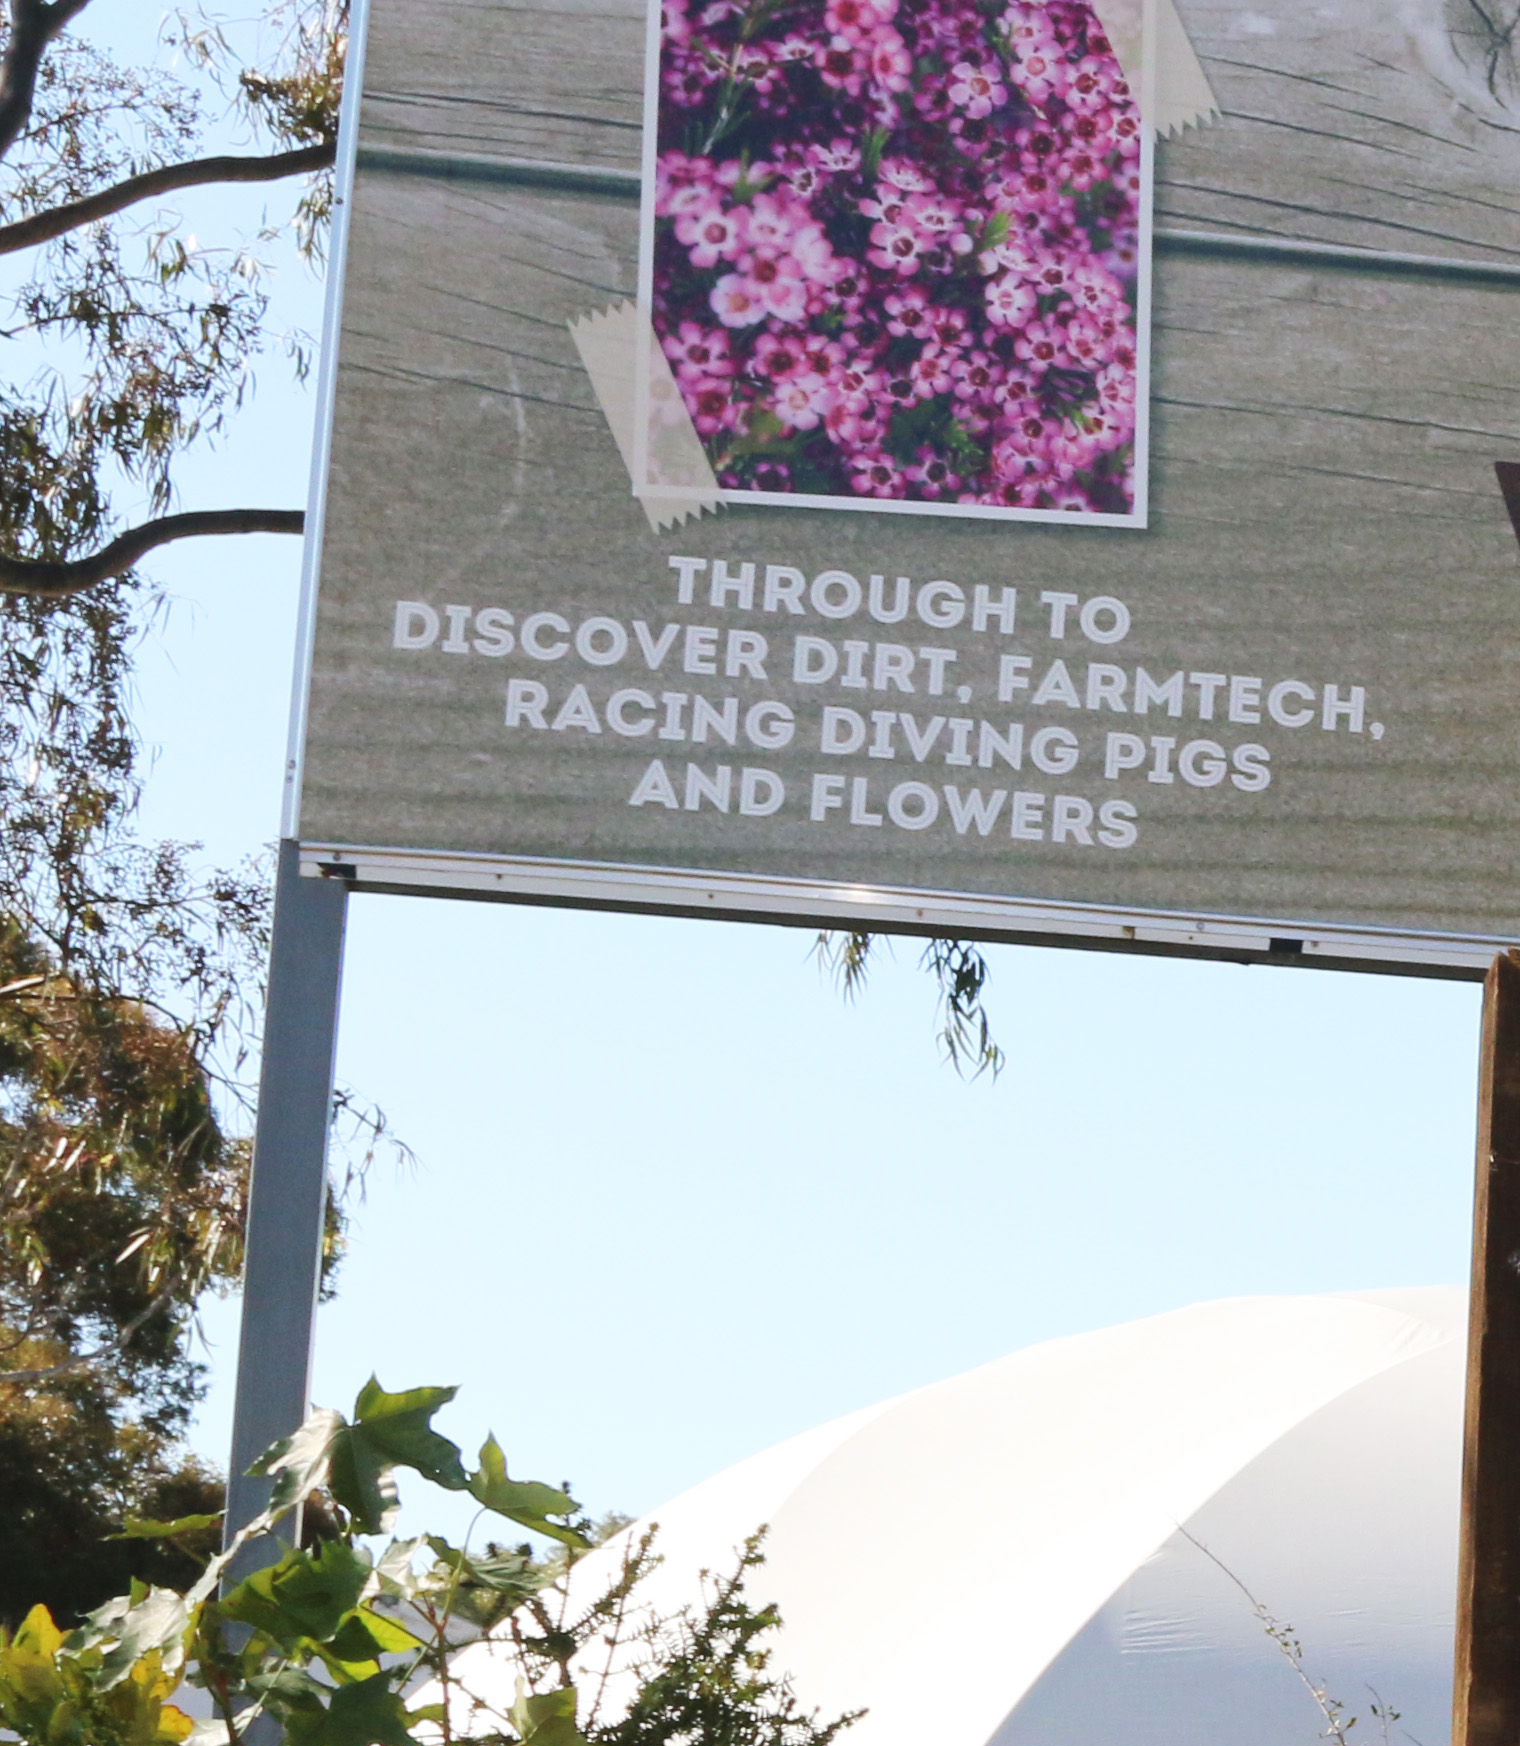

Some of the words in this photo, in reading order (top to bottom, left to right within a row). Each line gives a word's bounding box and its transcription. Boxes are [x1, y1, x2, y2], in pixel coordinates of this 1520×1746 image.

[669, 555, 1016, 634] THROUGH
[1041, 591, 1132, 643] TO
[393, 602, 769, 678] DISCOVER
[793, 635, 973, 704] DIRT,
[998, 656, 1387, 740] FARMTECH,
[504, 679, 797, 749] RACING
[820, 706, 1080, 775] DIVING
[1105, 733, 1273, 792] PIGS
[629, 759, 786, 817] AND
[811, 774, 1138, 848] FLOWERS
